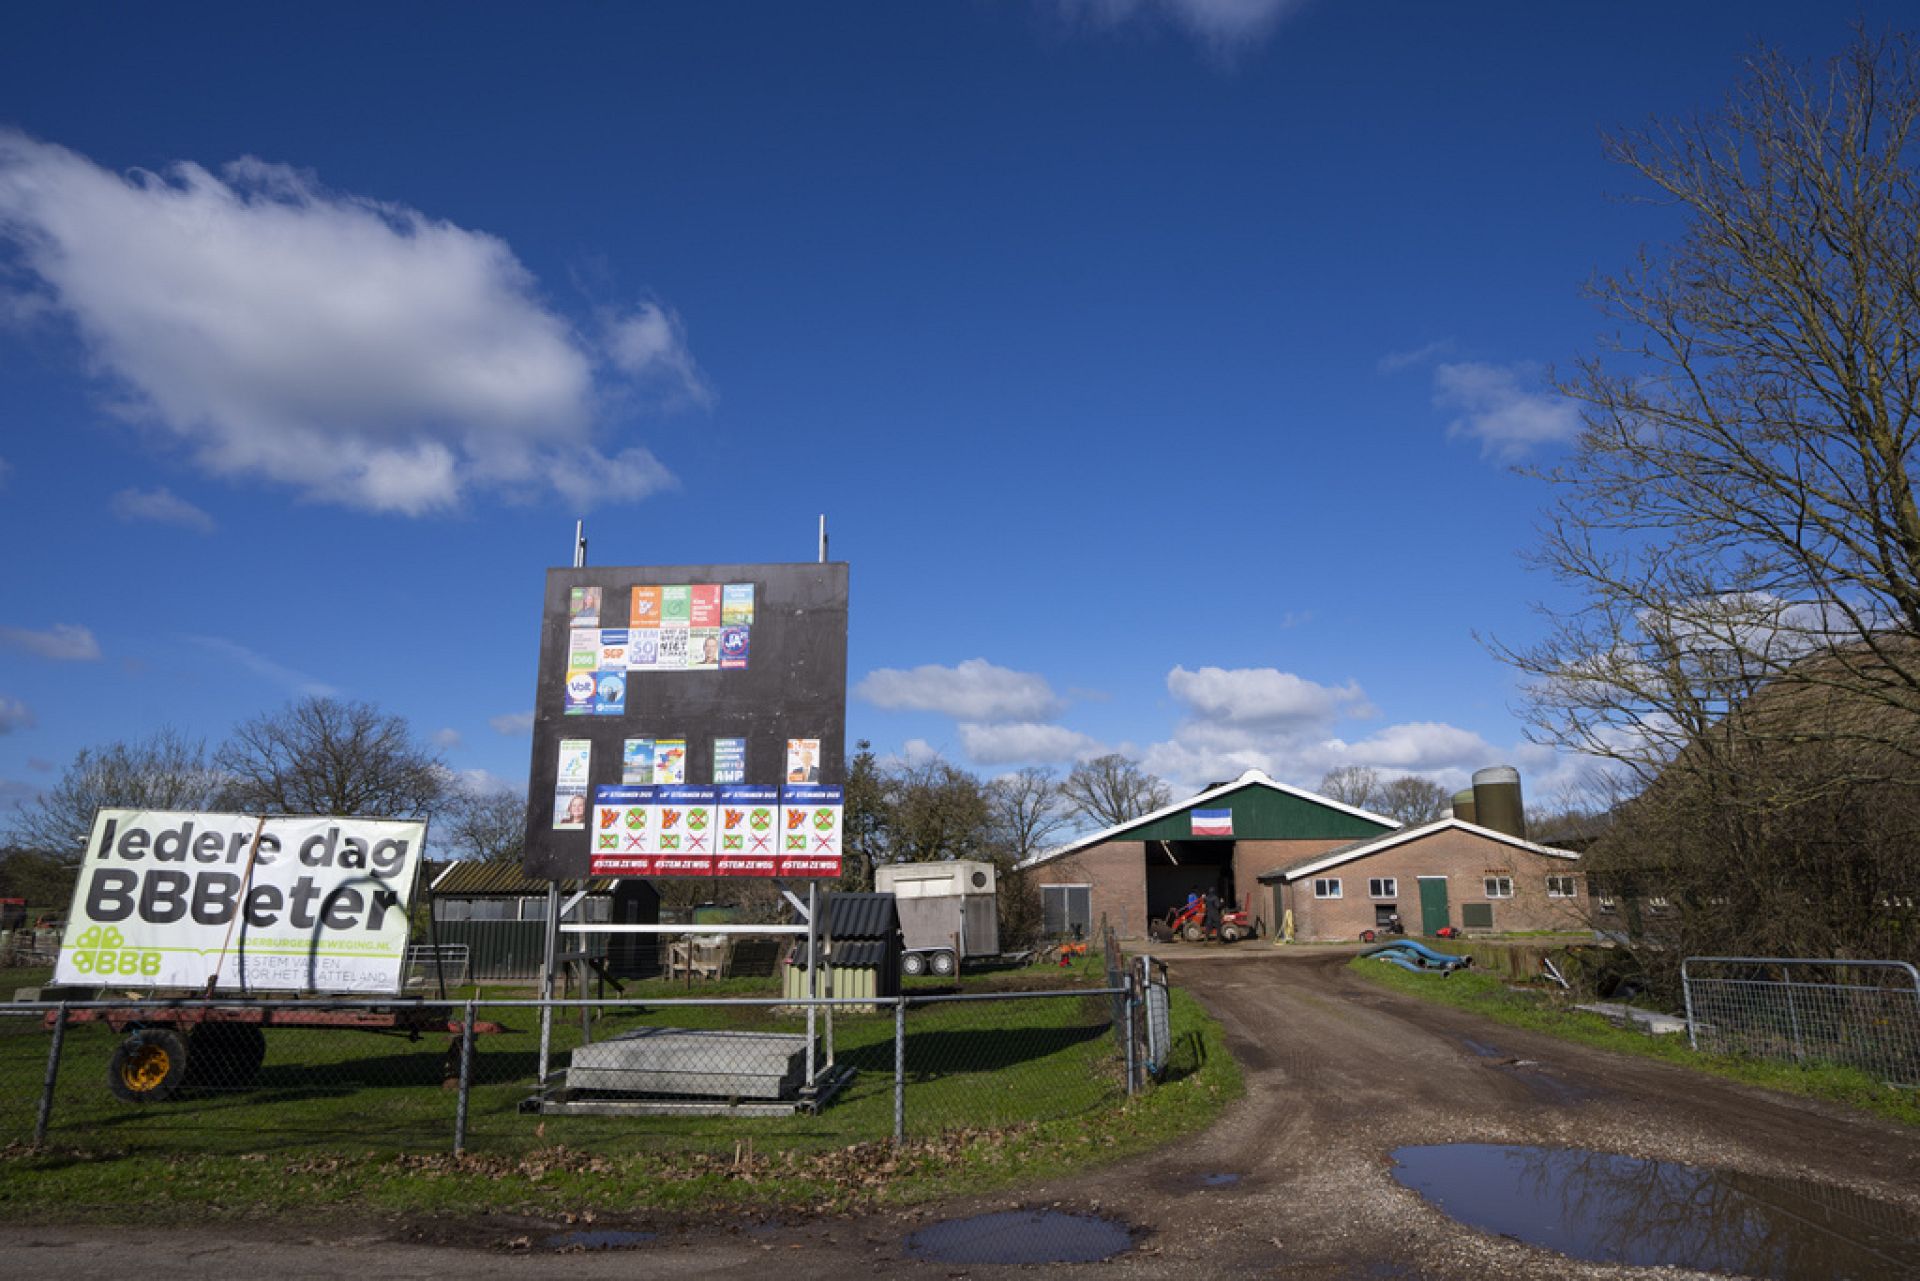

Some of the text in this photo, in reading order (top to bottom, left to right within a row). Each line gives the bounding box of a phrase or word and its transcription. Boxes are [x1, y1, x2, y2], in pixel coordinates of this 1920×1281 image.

[571, 682, 592, 692] Volt
[715, 770, 744, 781] AWP
[97, 818, 409, 878] Iedere dag
[86, 867, 398, 930] BBBeter
[95, 951, 162, 976] BBB
[253, 958, 287, 967] STEM
[323, 959, 340, 969] EN
[274, 969, 297, 980] HET
